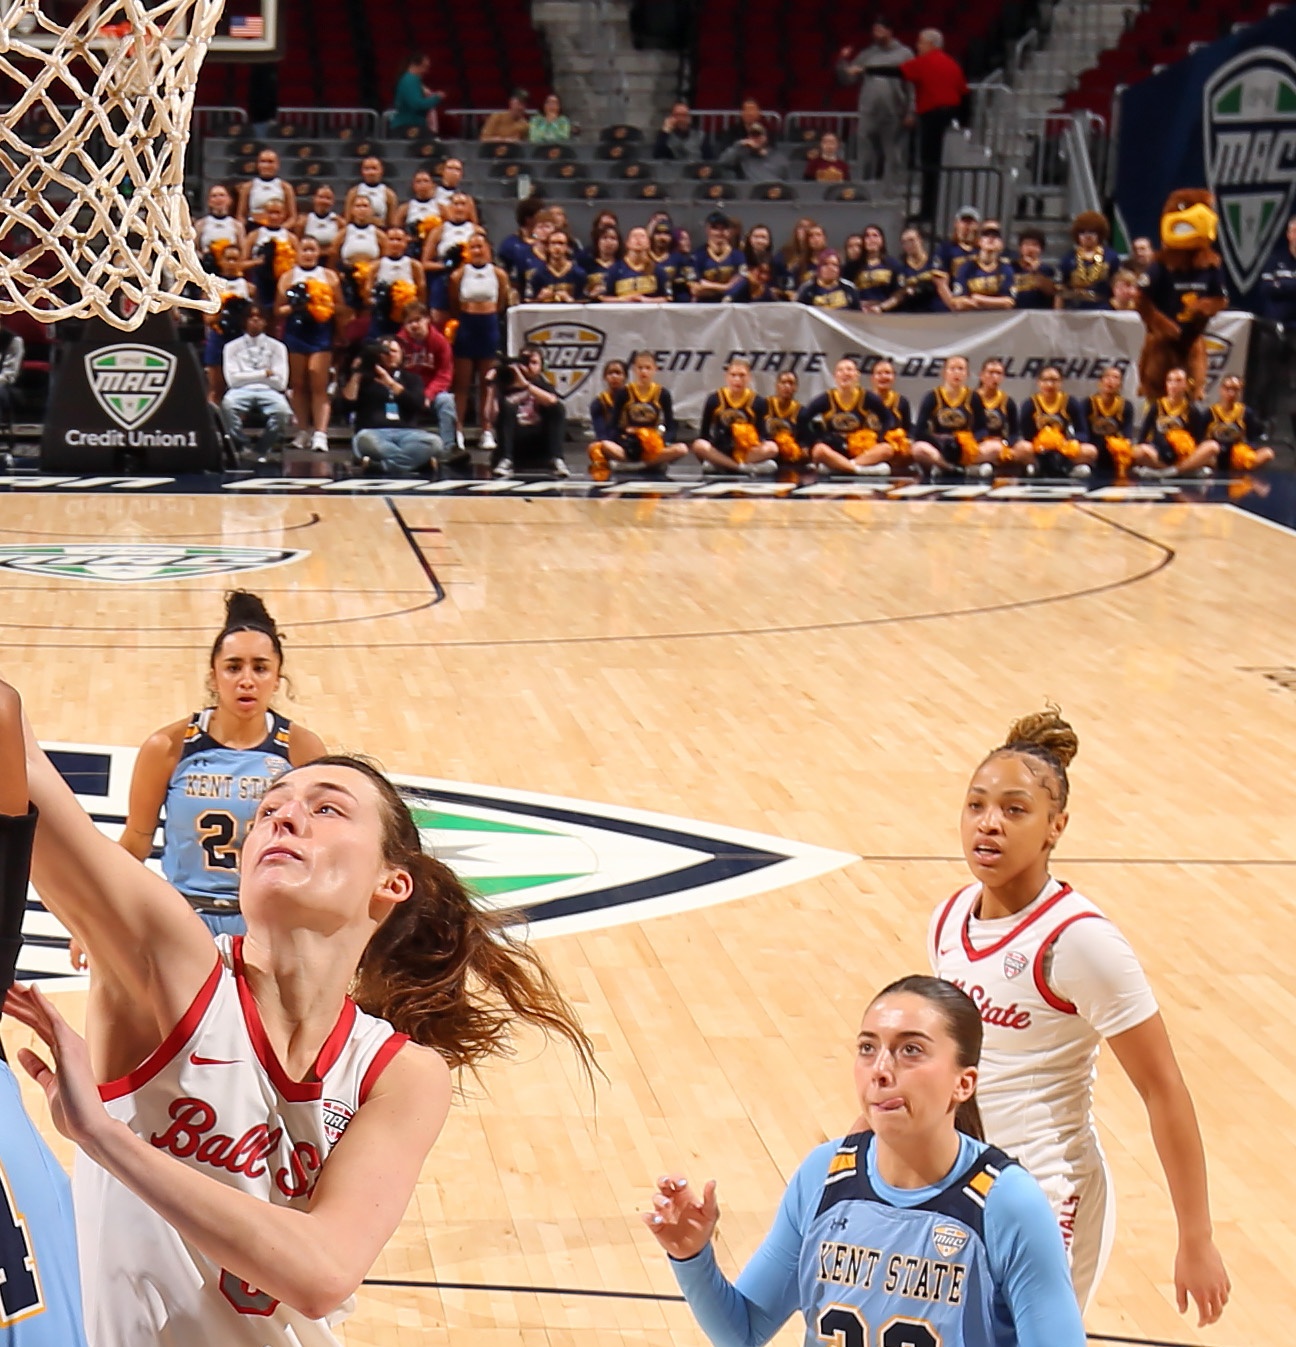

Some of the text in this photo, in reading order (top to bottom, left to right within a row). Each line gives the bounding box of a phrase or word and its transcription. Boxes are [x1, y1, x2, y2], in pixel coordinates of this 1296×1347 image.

[94, 372, 167, 392] MAC
[65, 429, 125, 447] Credit
[186, 774, 233, 798] KENT
[195, 809, 254, 873] 2
[150, 1097, 283, 1178] Ball
[934, 1233, 967, 1247] MAC
[817, 1241, 966, 1306] KENT STATE
